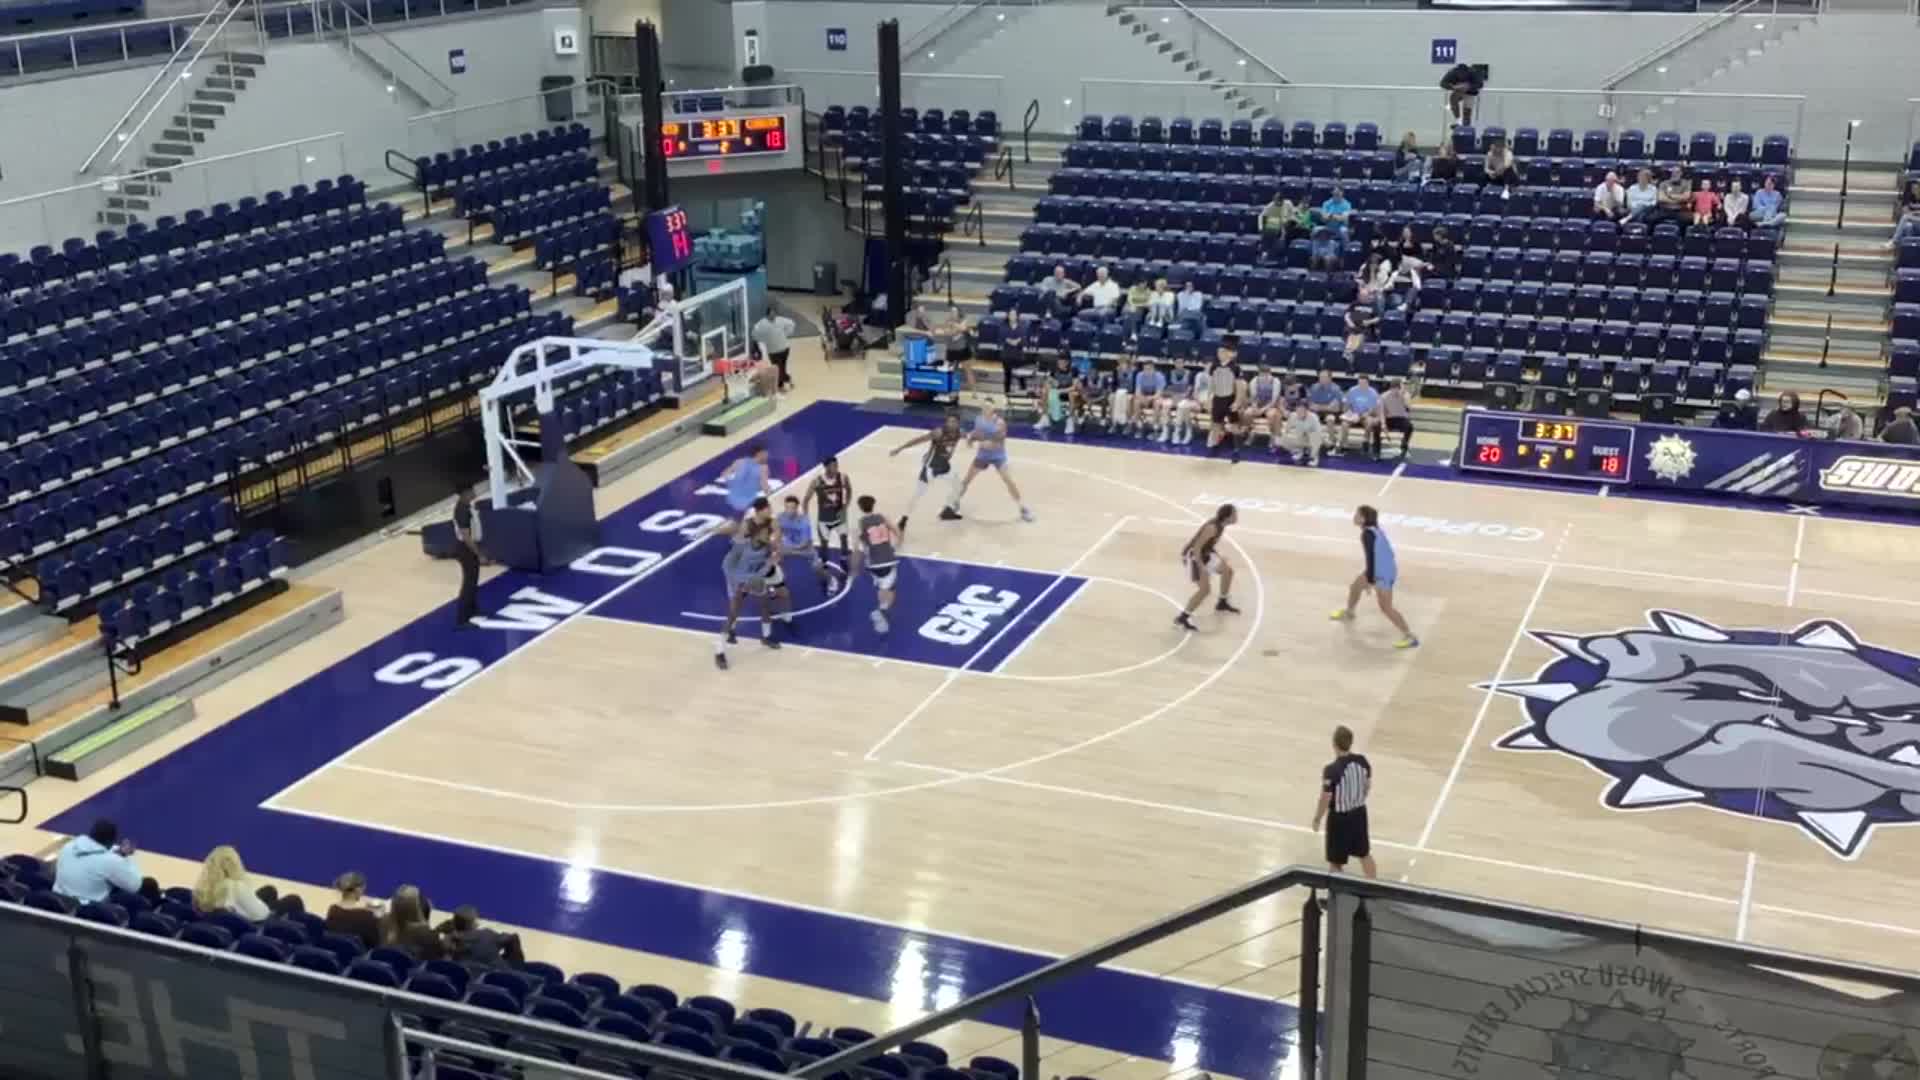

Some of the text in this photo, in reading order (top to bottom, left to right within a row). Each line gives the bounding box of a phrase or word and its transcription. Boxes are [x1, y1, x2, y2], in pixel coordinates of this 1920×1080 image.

[1436, 46, 1455, 57] 111
[1535, 423, 1574, 439] 3:37
[1480, 446, 1501, 462] 20
[1539, 452, 1550, 469] 2
[1602, 457, 1618, 472] 18
[1825, 459, 1920, 494] SWO
[918, 584, 1020, 646] GAC
